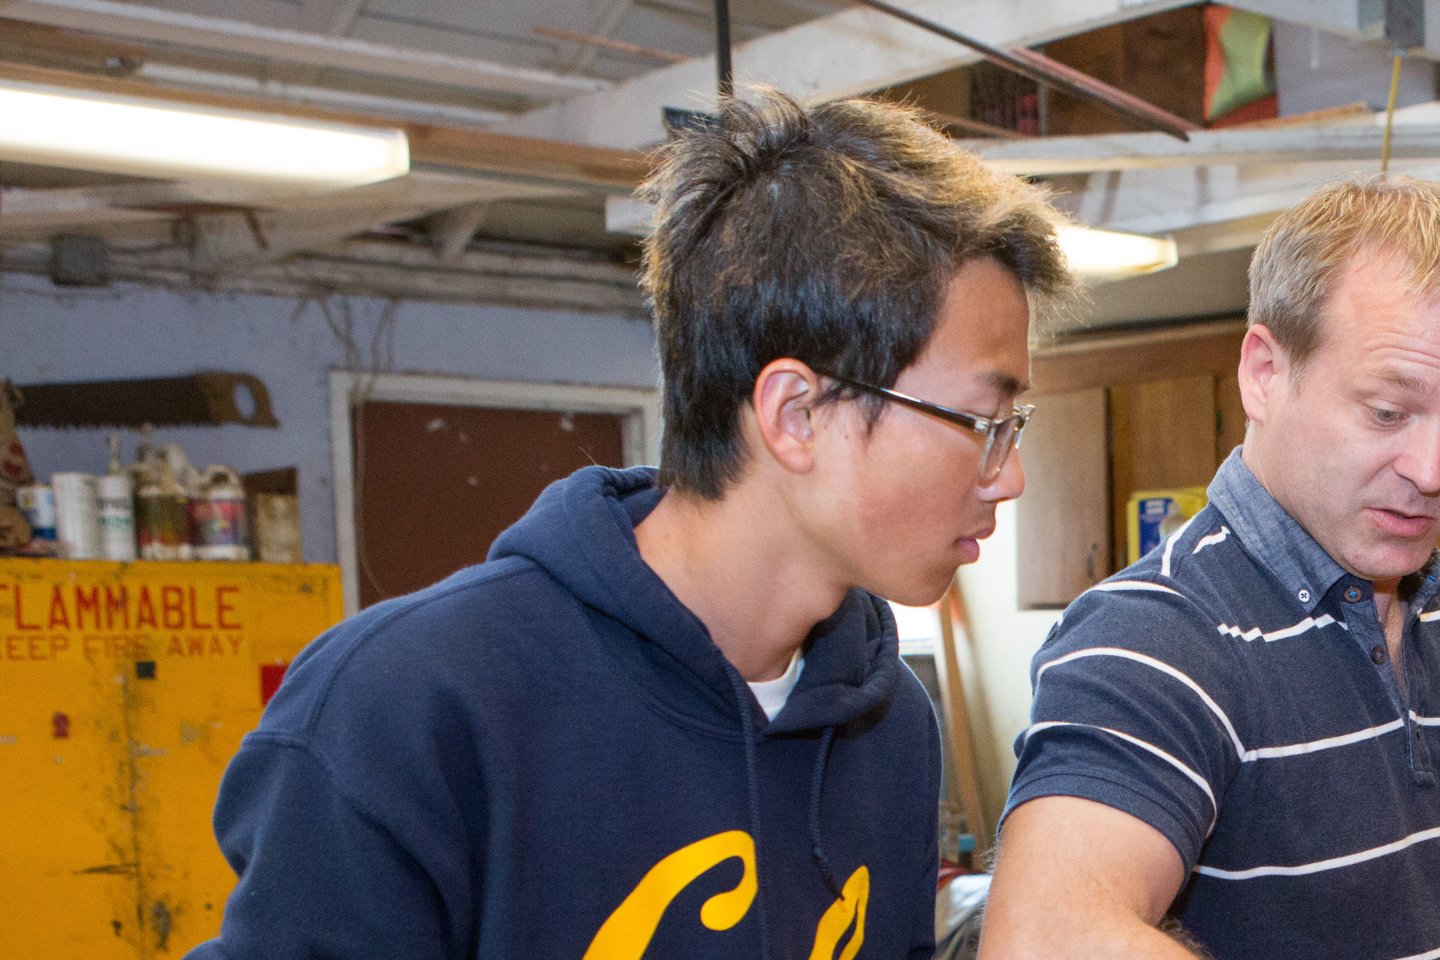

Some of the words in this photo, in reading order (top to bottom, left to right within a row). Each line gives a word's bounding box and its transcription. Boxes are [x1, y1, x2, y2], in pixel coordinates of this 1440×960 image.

[0, 584, 242, 630] LAMMABLE
[0, 635, 69, 660] EEP
[167, 635, 243, 658] AWAY
